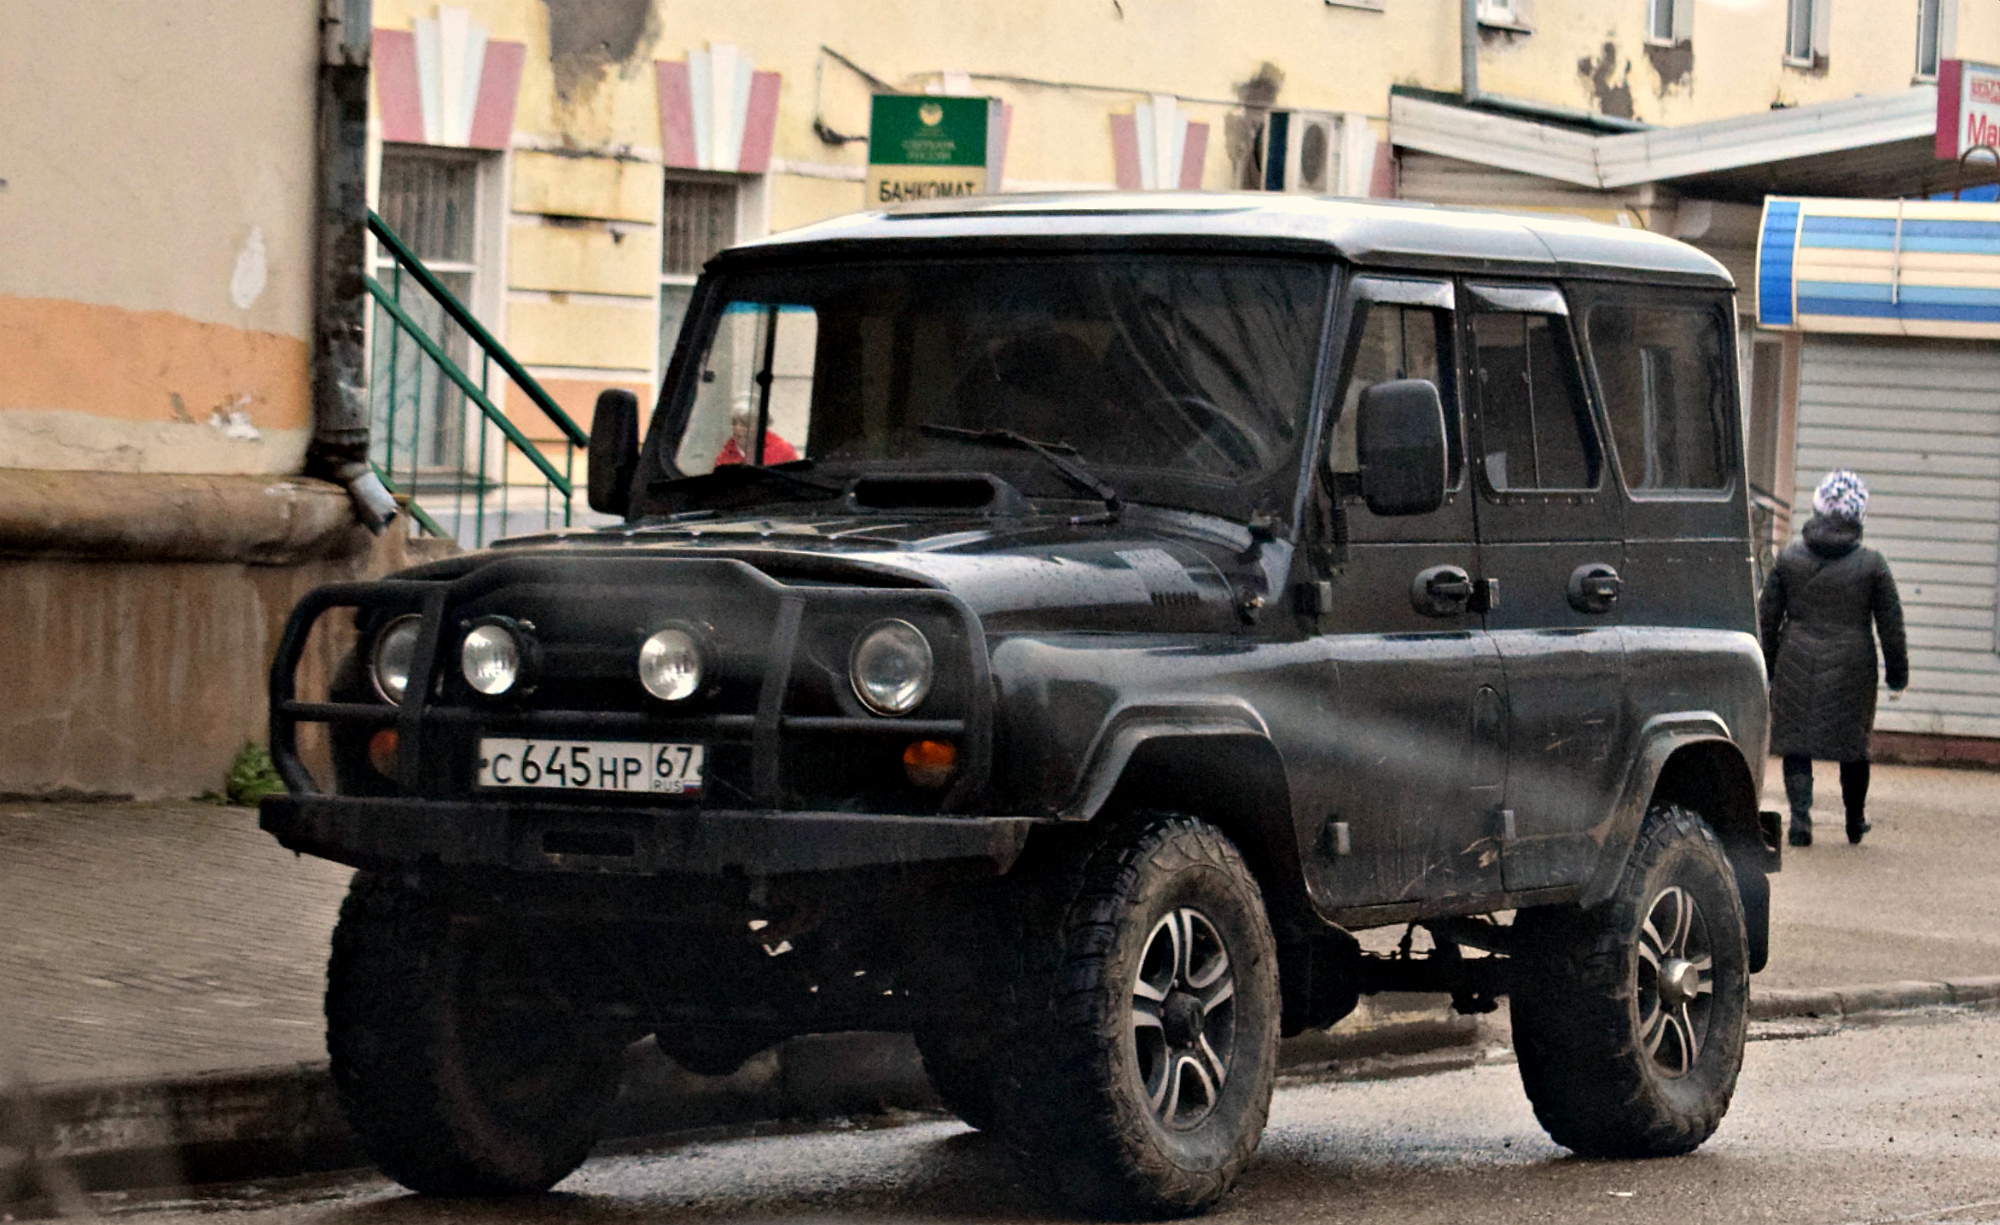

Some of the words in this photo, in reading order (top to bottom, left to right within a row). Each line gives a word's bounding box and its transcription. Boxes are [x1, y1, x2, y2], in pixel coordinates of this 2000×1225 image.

[1968, 113, 2000, 147] Ма
[880, 181, 975, 202] БАНКОМАТ
[656, 746, 693, 778] 67
[654, 779, 682, 792] RUS
